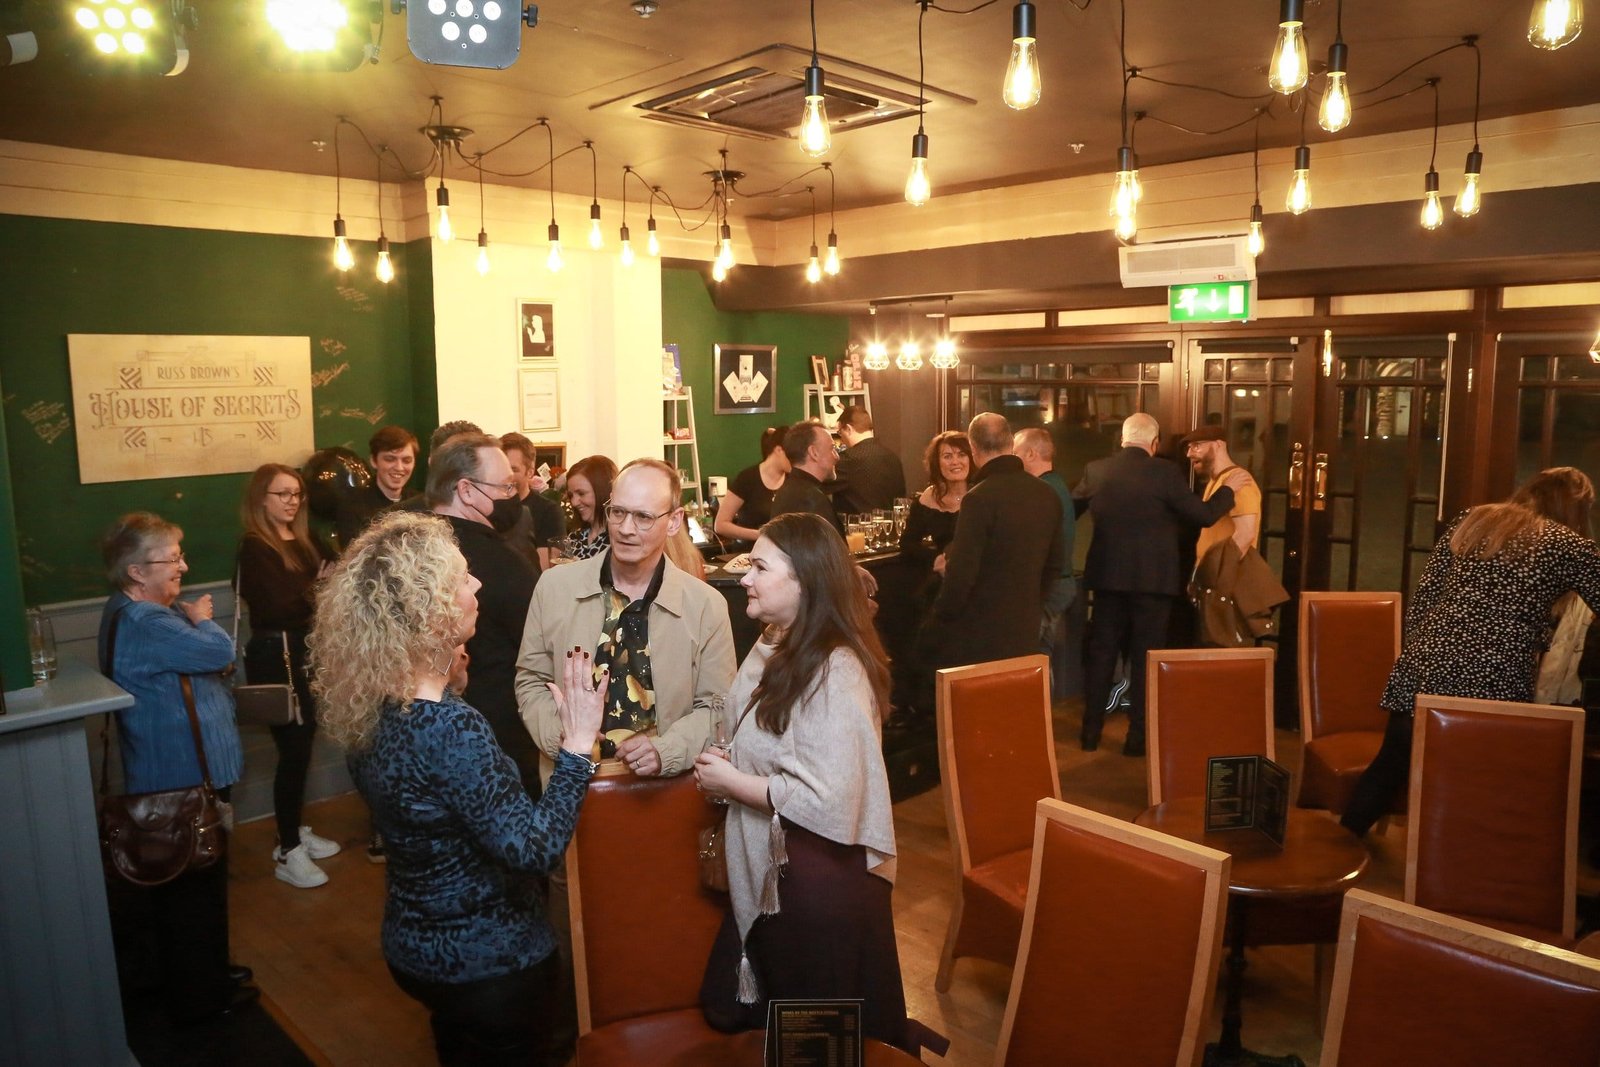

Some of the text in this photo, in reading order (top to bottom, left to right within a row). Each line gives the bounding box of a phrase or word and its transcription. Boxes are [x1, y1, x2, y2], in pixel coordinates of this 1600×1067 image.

[157, 366, 240, 379] RUSS BROWN'S
[89, 391, 173, 430] HOUSE
[181, 396, 206, 418] OF
[213, 388, 302, 420] SECRETS
